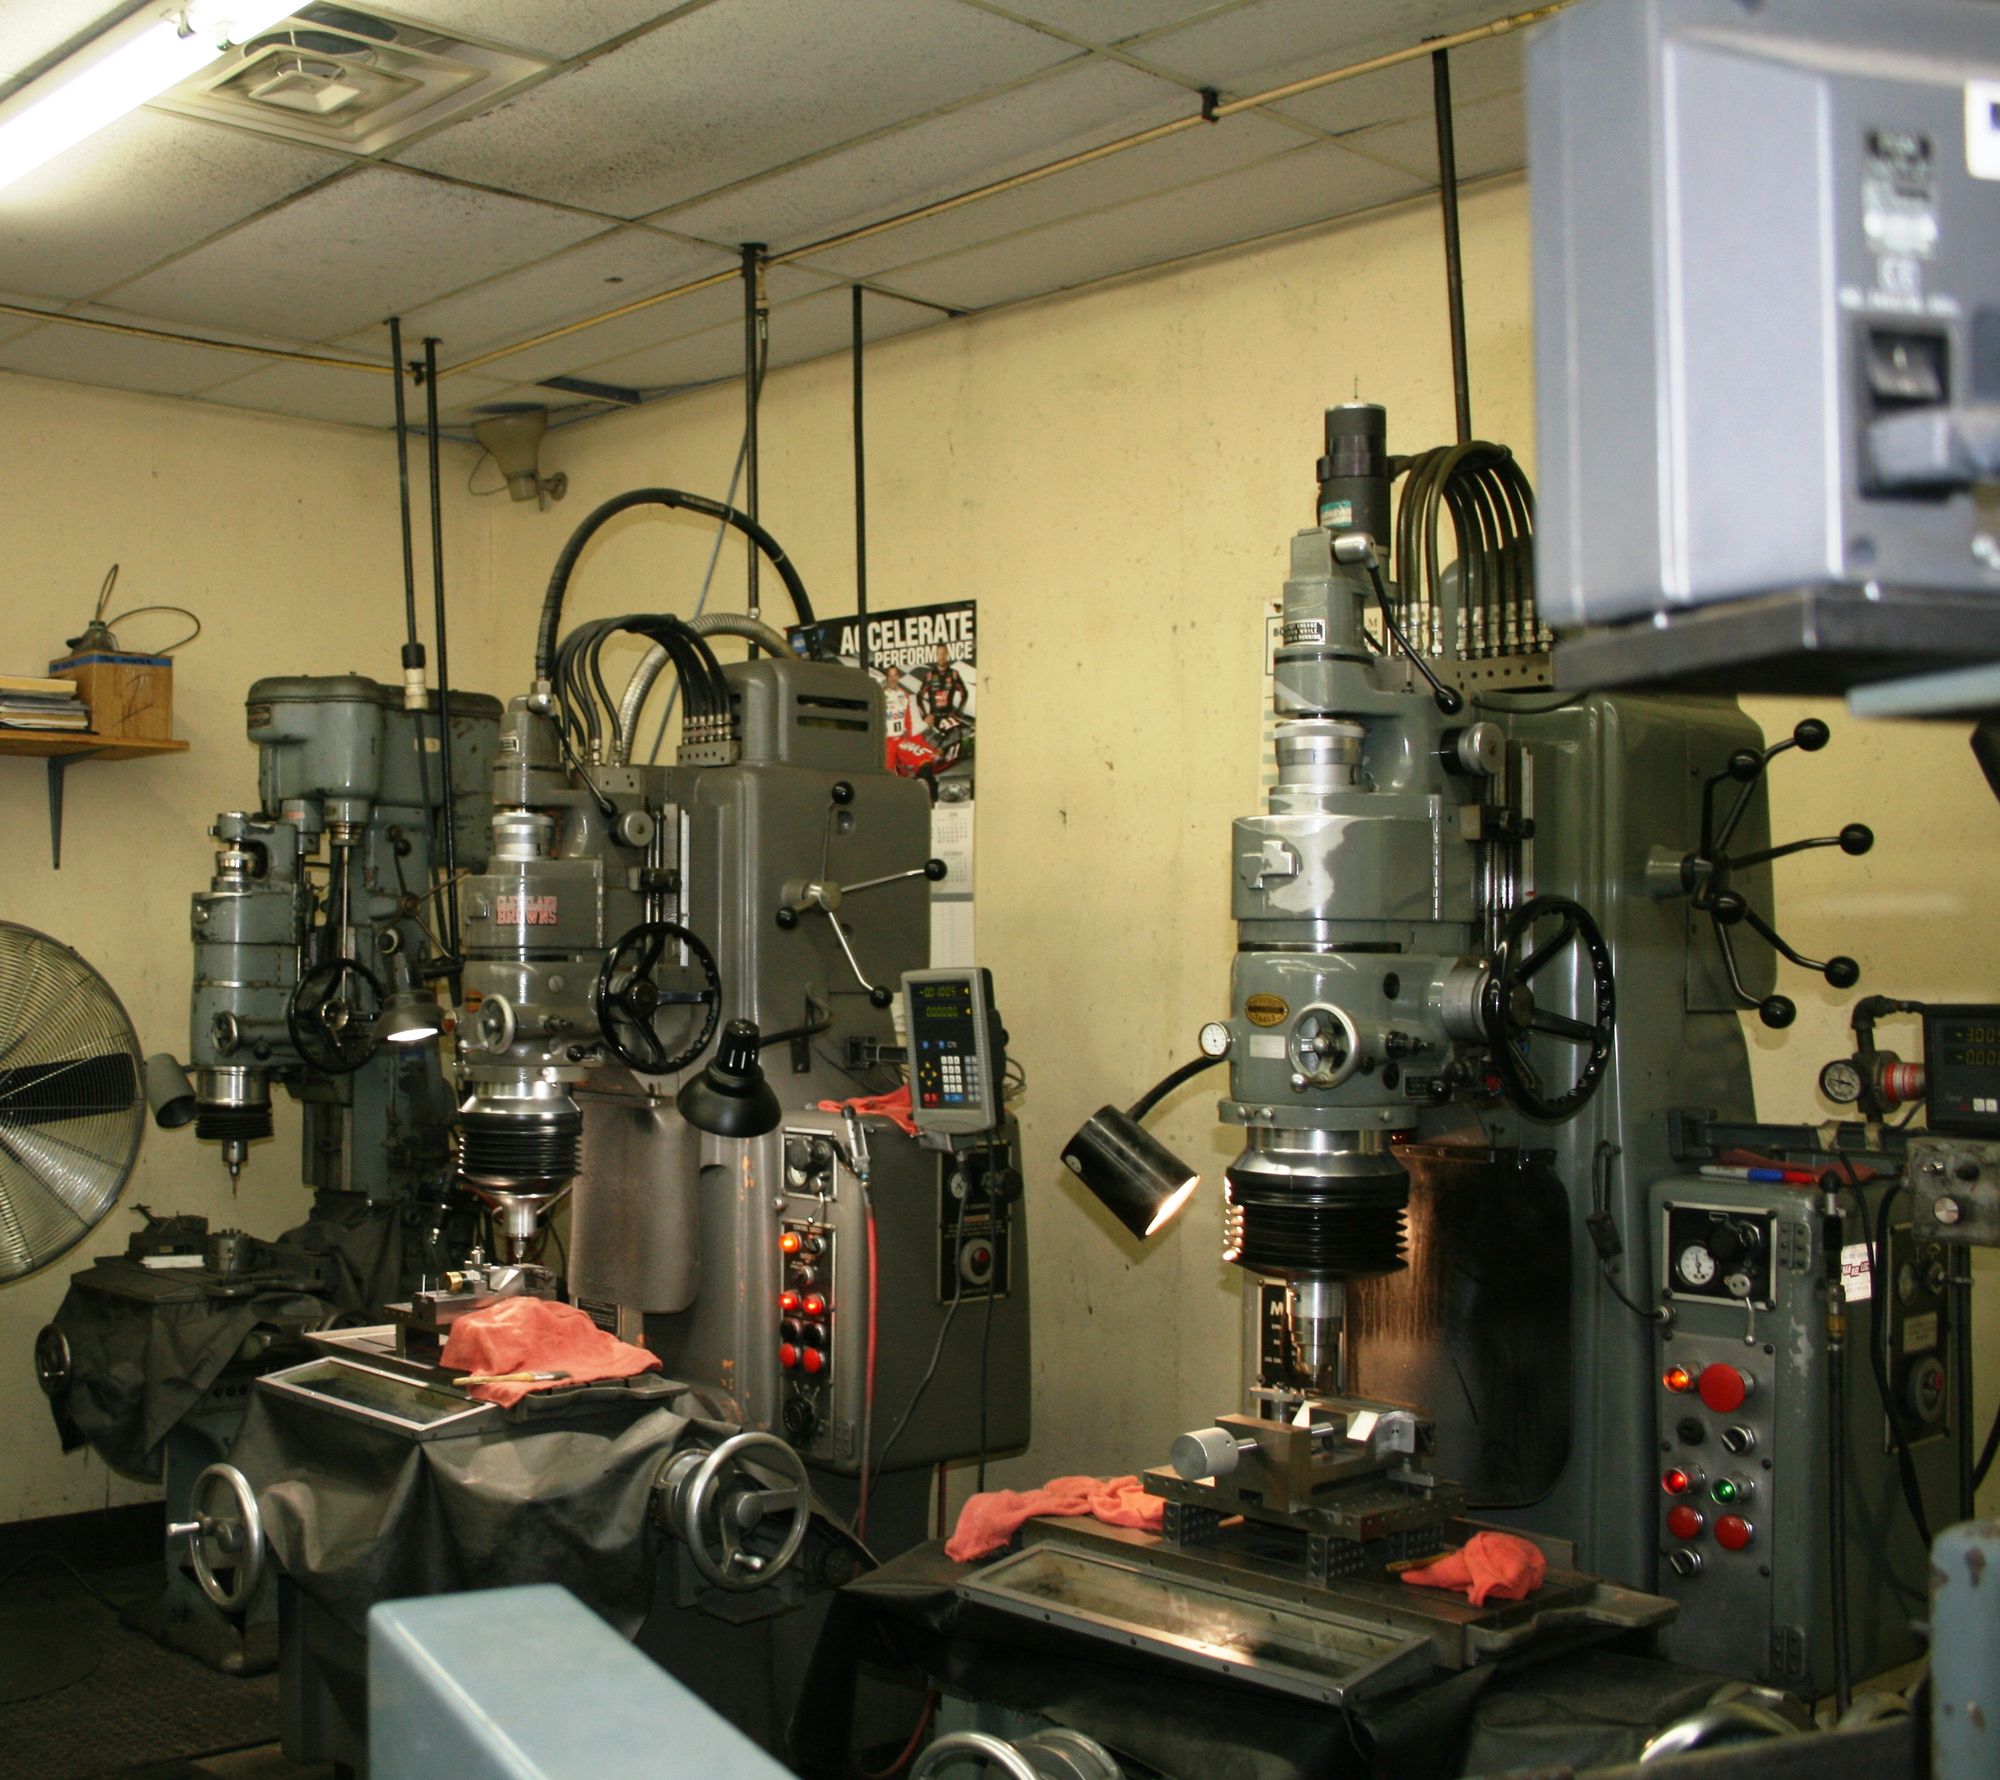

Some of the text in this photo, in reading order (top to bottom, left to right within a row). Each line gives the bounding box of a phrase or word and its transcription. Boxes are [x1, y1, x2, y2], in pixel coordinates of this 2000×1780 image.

[874, 641, 973, 668] PERFORMNCE
[497, 896, 557, 909] CLEELAND
[497, 909, 557, 925] BRWNS
